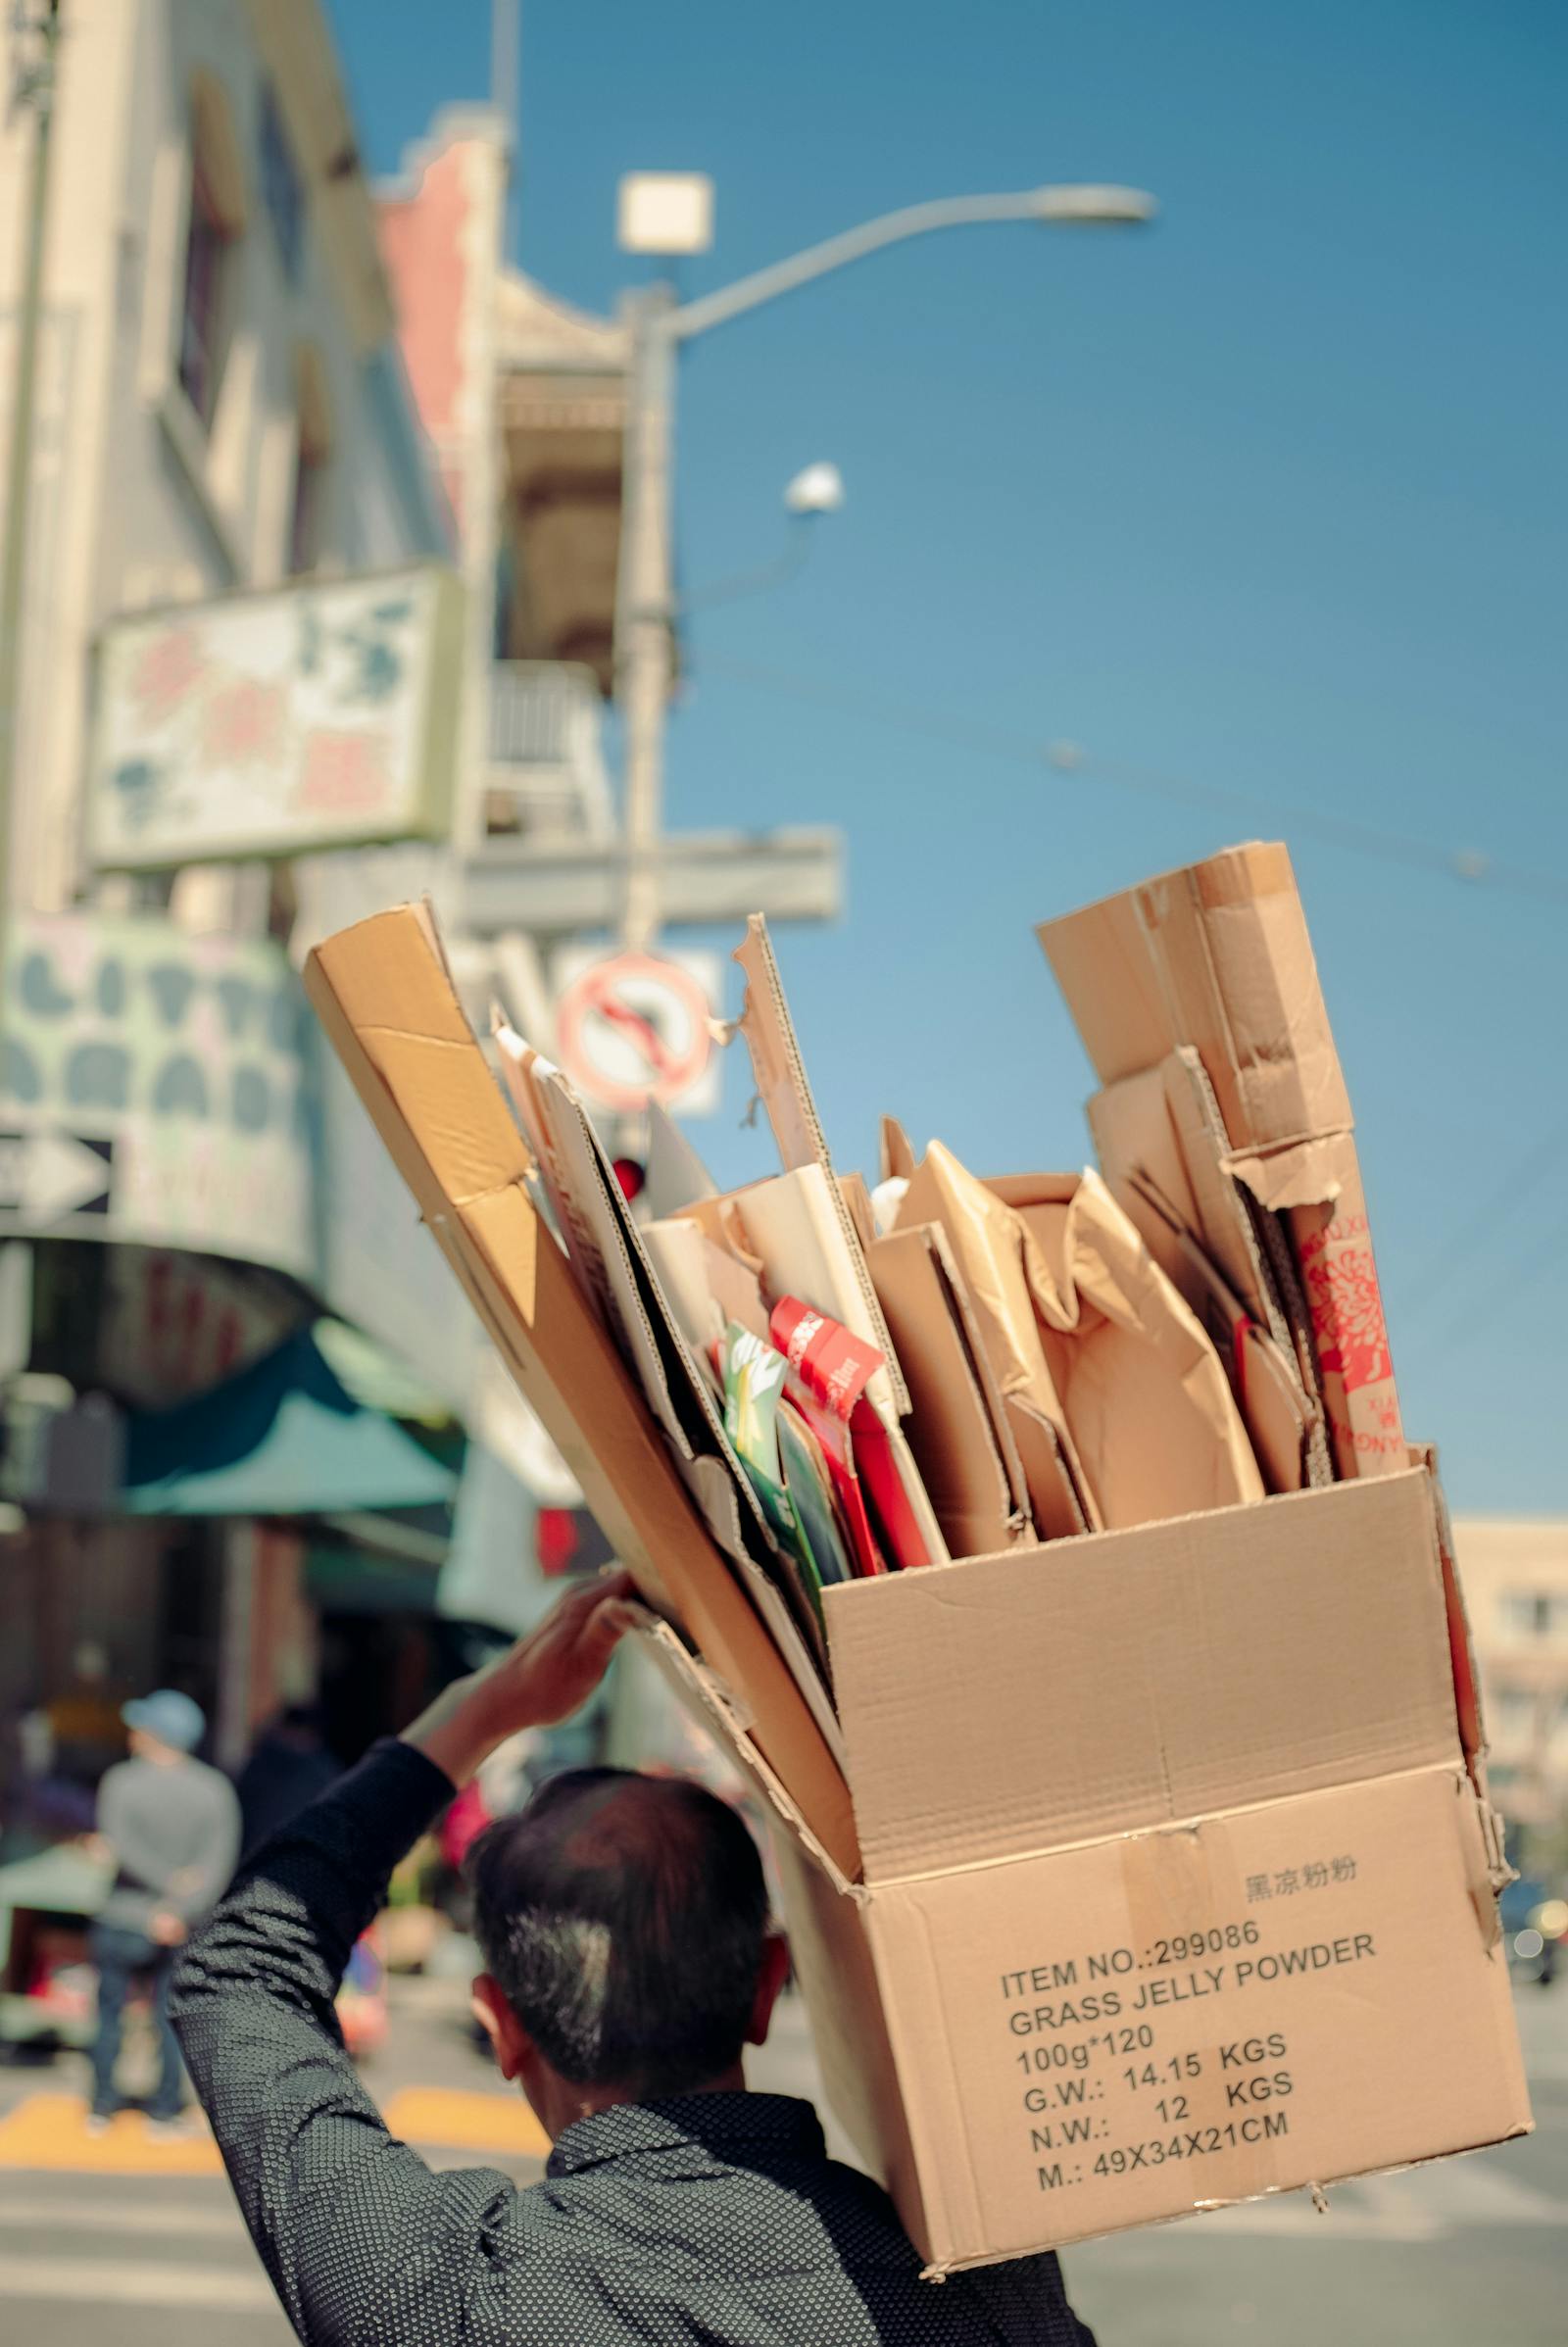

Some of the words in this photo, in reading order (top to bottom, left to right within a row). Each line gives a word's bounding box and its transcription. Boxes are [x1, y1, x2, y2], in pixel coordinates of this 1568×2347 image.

[1001, 1960, 1078, 1999] ITEM
[1008, 1991, 1122, 2036] GRASS
[1134, 1967, 1224, 2010] JELLY
[1235, 1933, 1376, 1987] POWDER
[1023, 2078, 1104, 2114] G.W.:
[1123, 2052, 1202, 2091] 14.15
[1218, 2032, 1287, 2071] KGS
[1030, 2117, 1109, 2153] N.W.:
[1154, 2095, 1191, 2124] 12
[1225, 2071, 1294, 2109] KGS
[1037, 2163, 1083, 2191] M.:
[1093, 2111, 1289, 2176] 49X34X21CM
